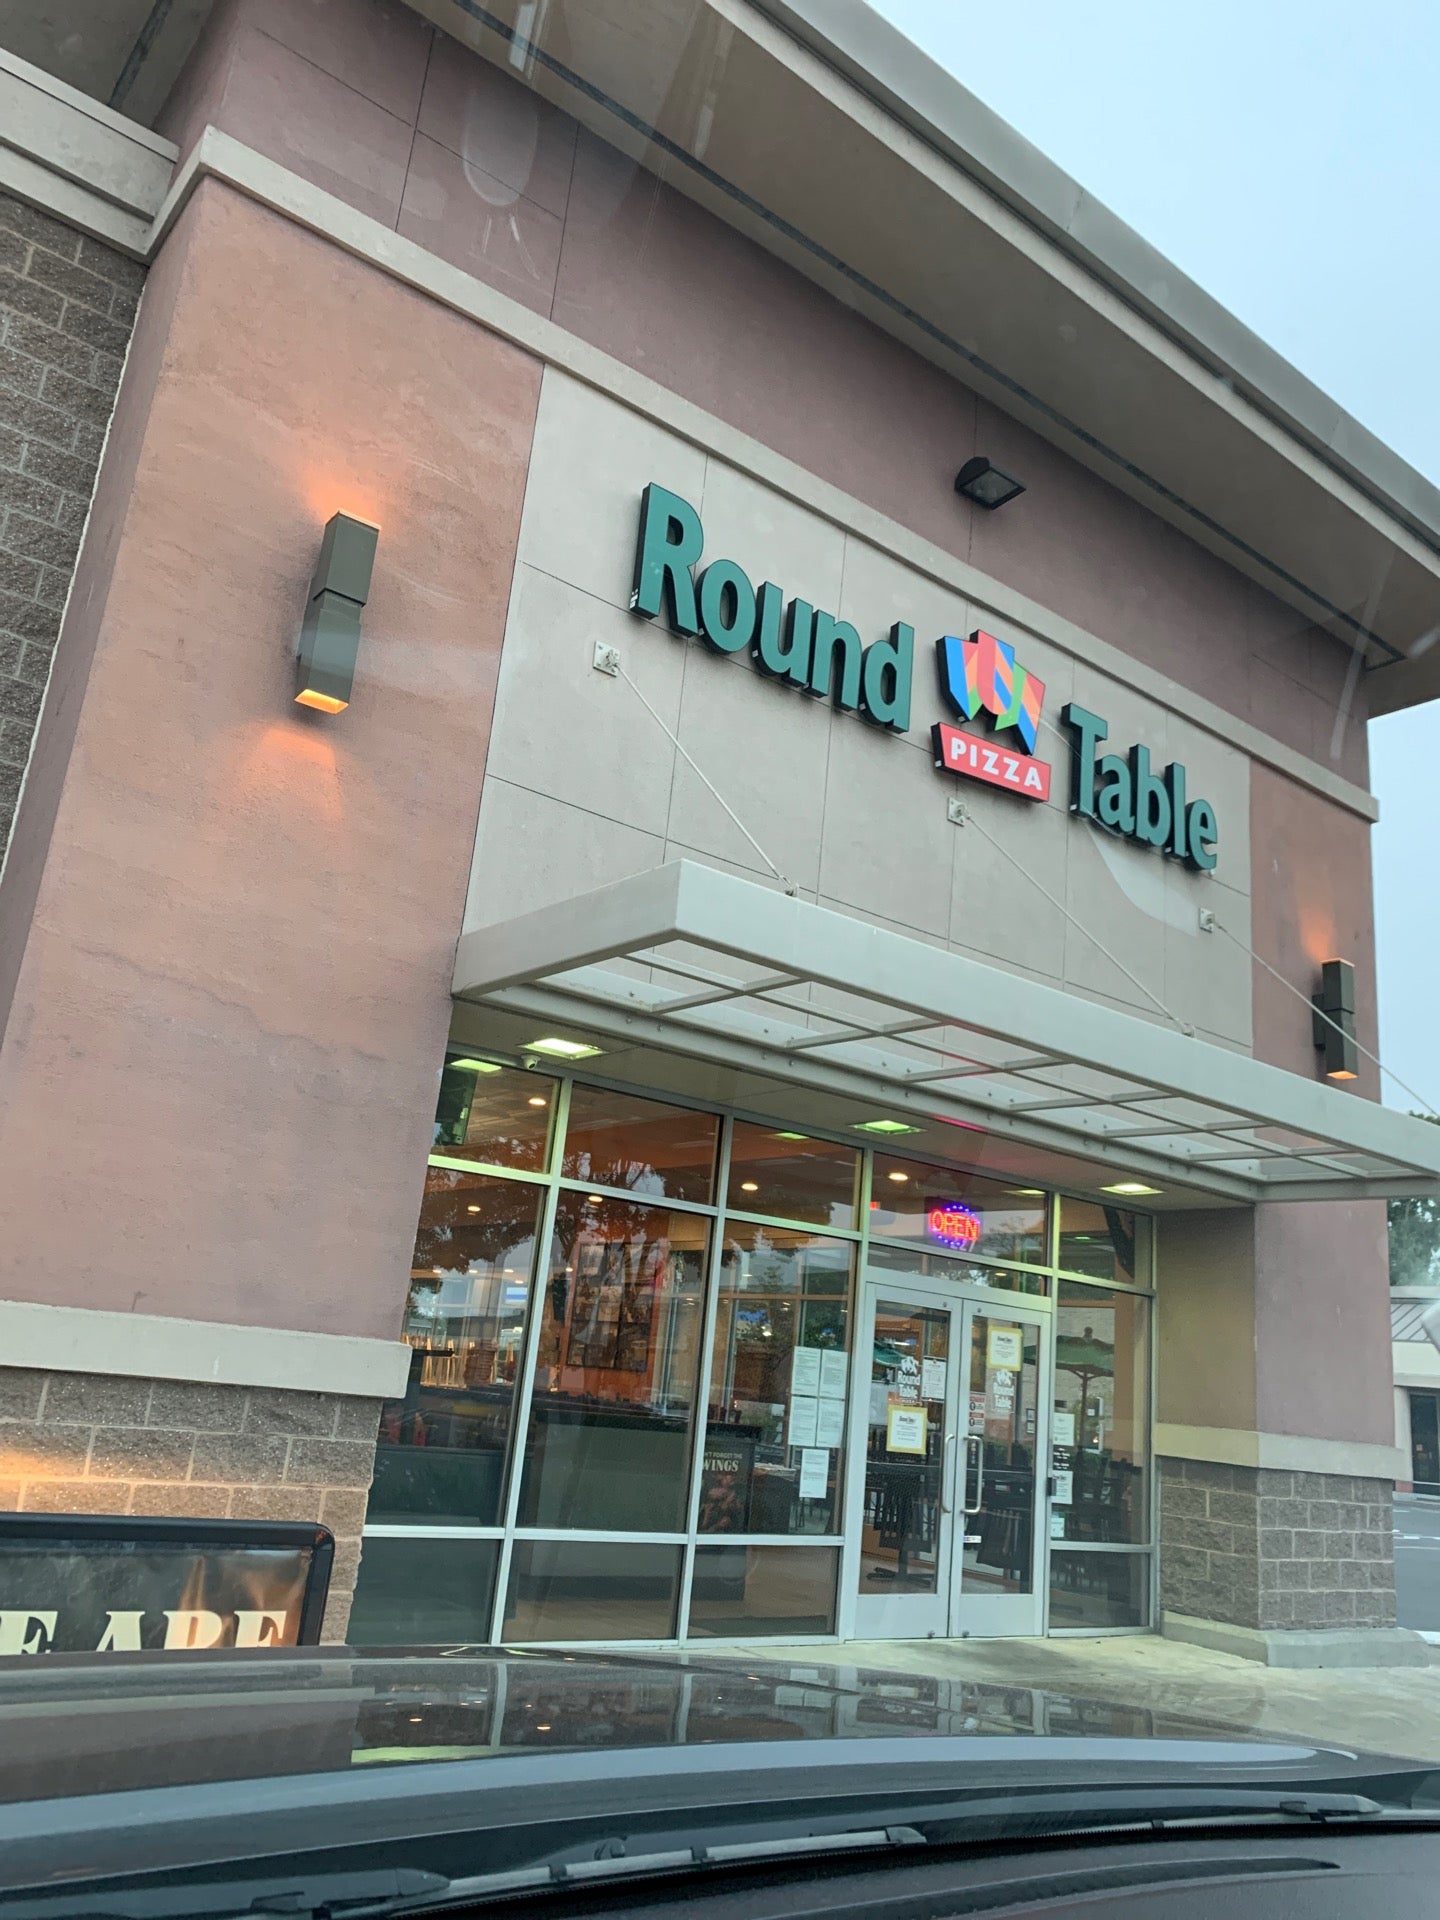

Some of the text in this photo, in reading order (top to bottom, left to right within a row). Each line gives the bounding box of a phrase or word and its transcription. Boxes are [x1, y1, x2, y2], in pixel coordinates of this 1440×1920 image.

[630, 482, 1218, 871] Round Table
[951, 736, 1043, 792] PIZZA
[929, 1209, 980, 1241] OPEN
